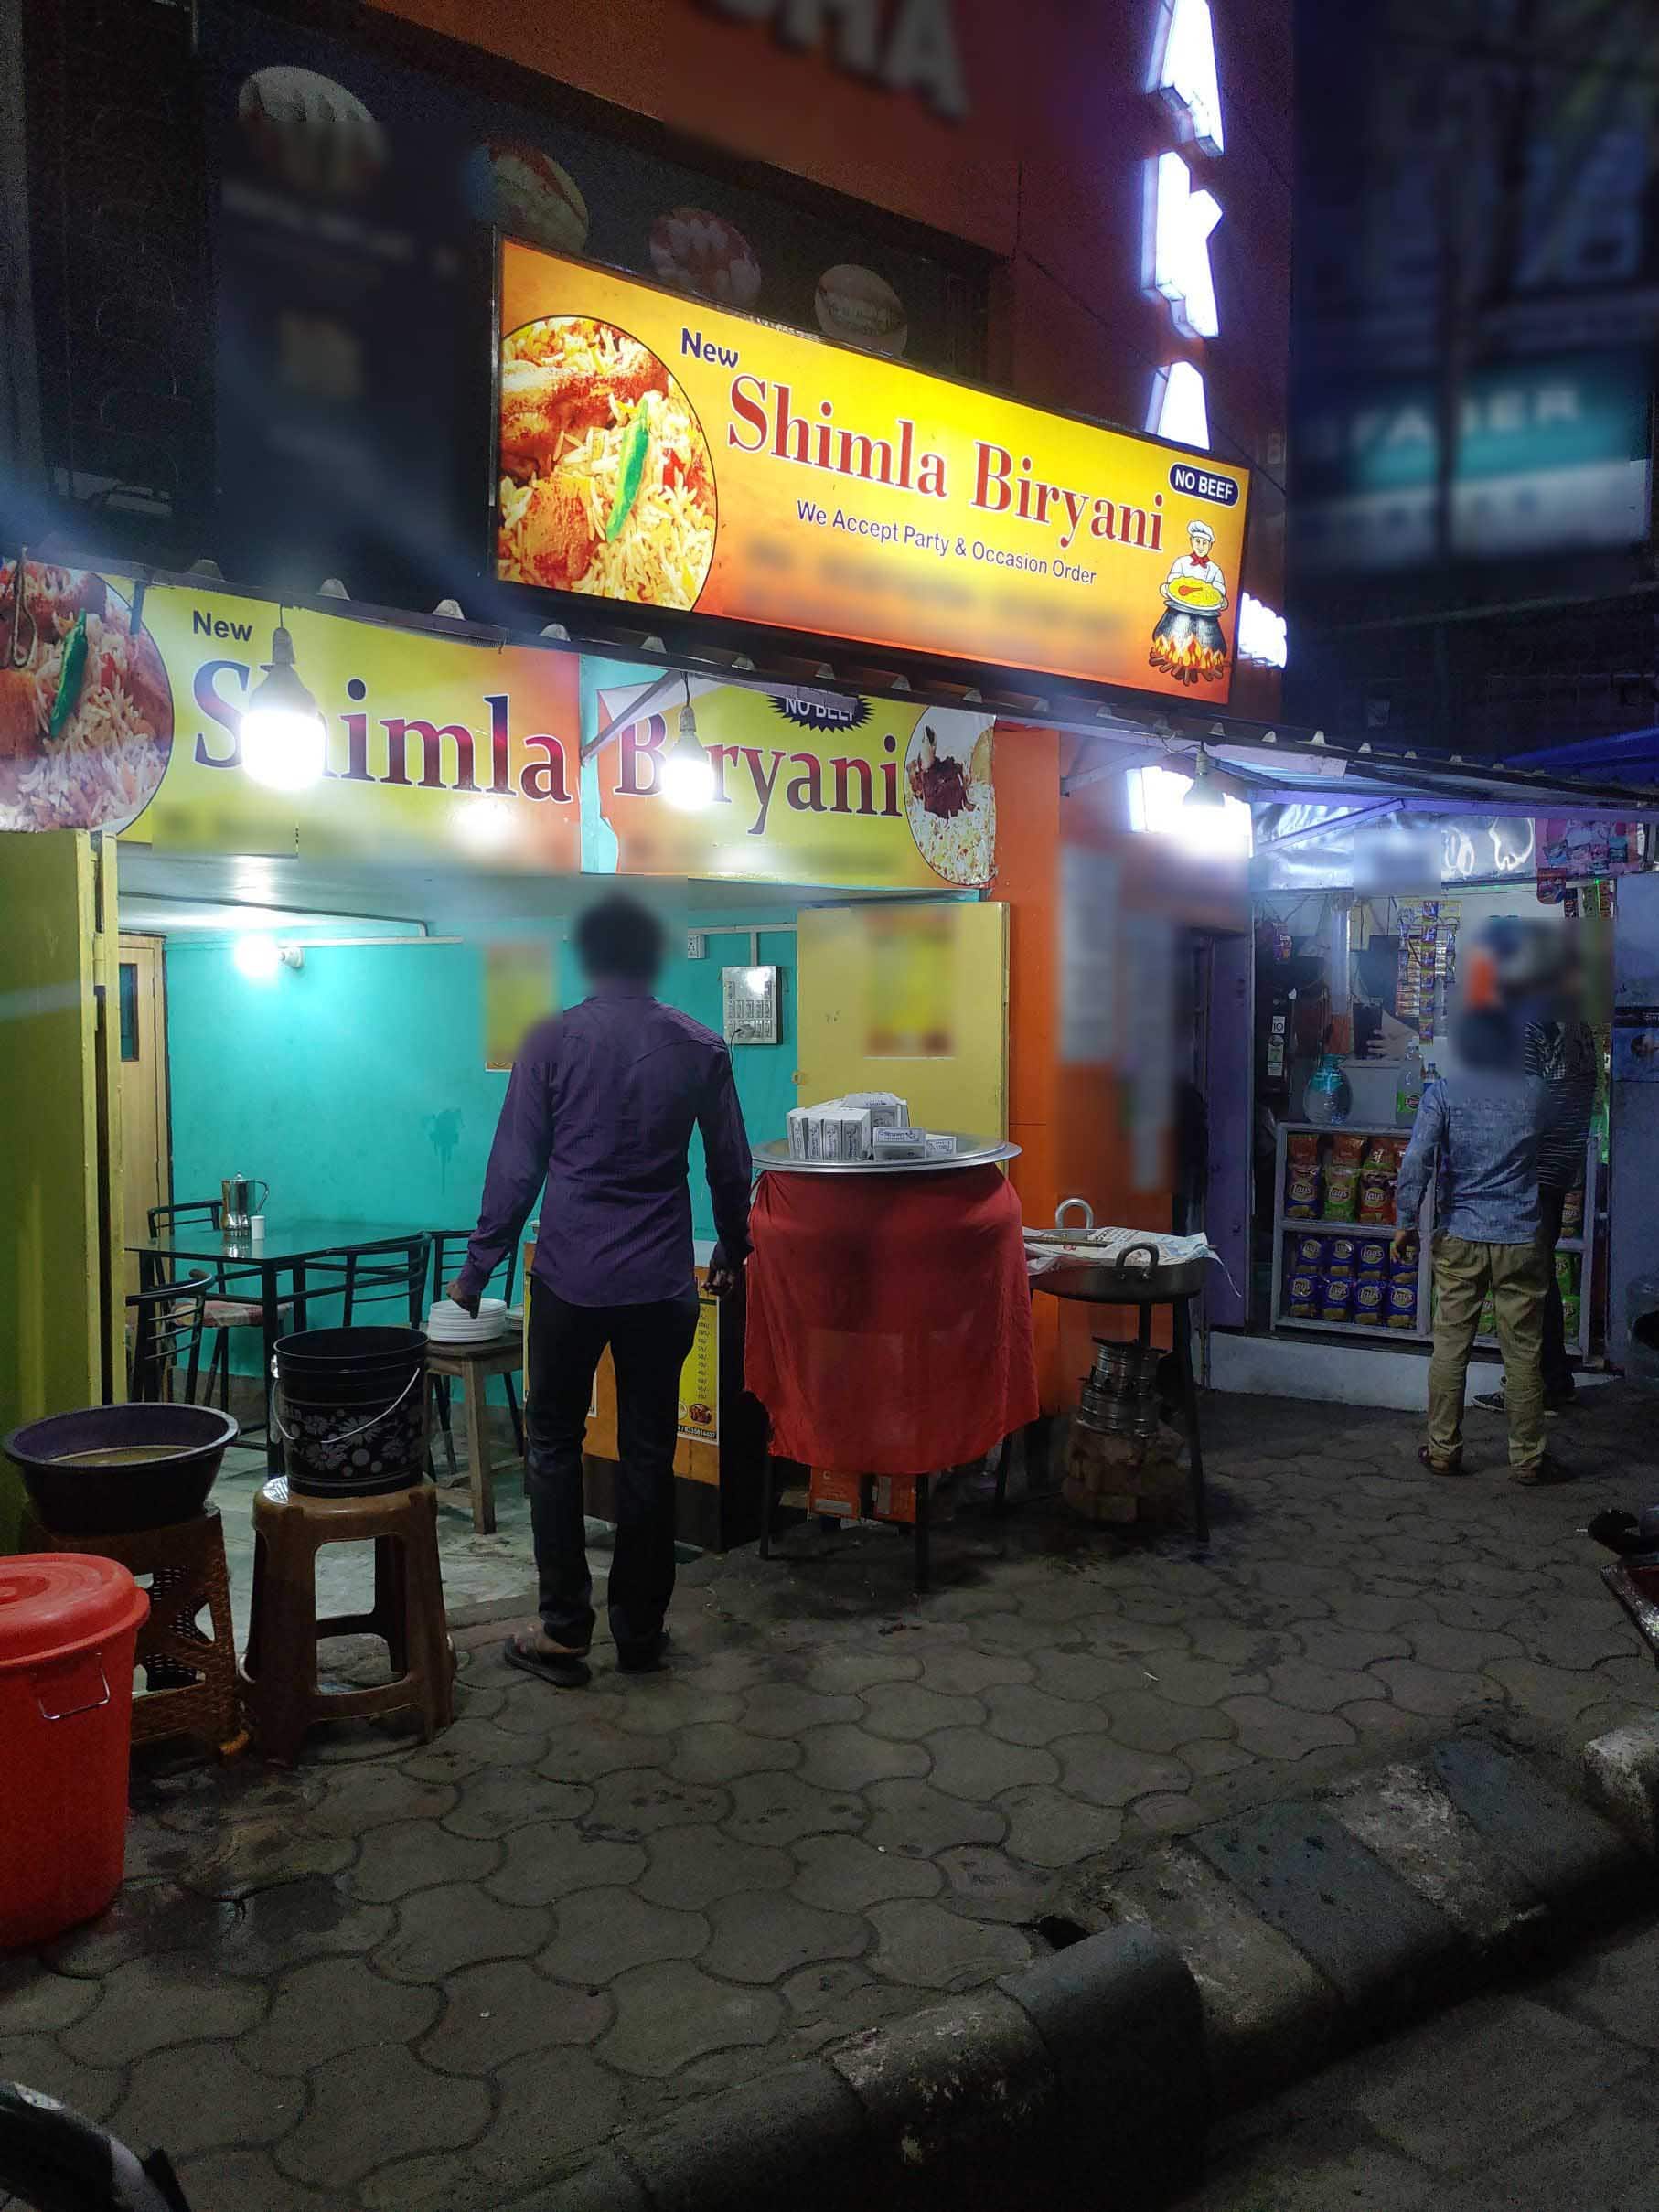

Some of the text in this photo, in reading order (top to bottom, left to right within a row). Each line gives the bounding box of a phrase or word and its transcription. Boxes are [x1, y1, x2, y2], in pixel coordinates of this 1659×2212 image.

[680, 327, 739, 369] New
[727, 374, 947, 498] Shimla
[970, 440, 1165, 551] Biryani
[1174, 468, 1235, 501] NO BEEF
[797, 499, 1097, 584] We Accept Party & Occasion Order
[193, 610, 252, 642] New
[193, 659, 904, 836] Simla Bryani
